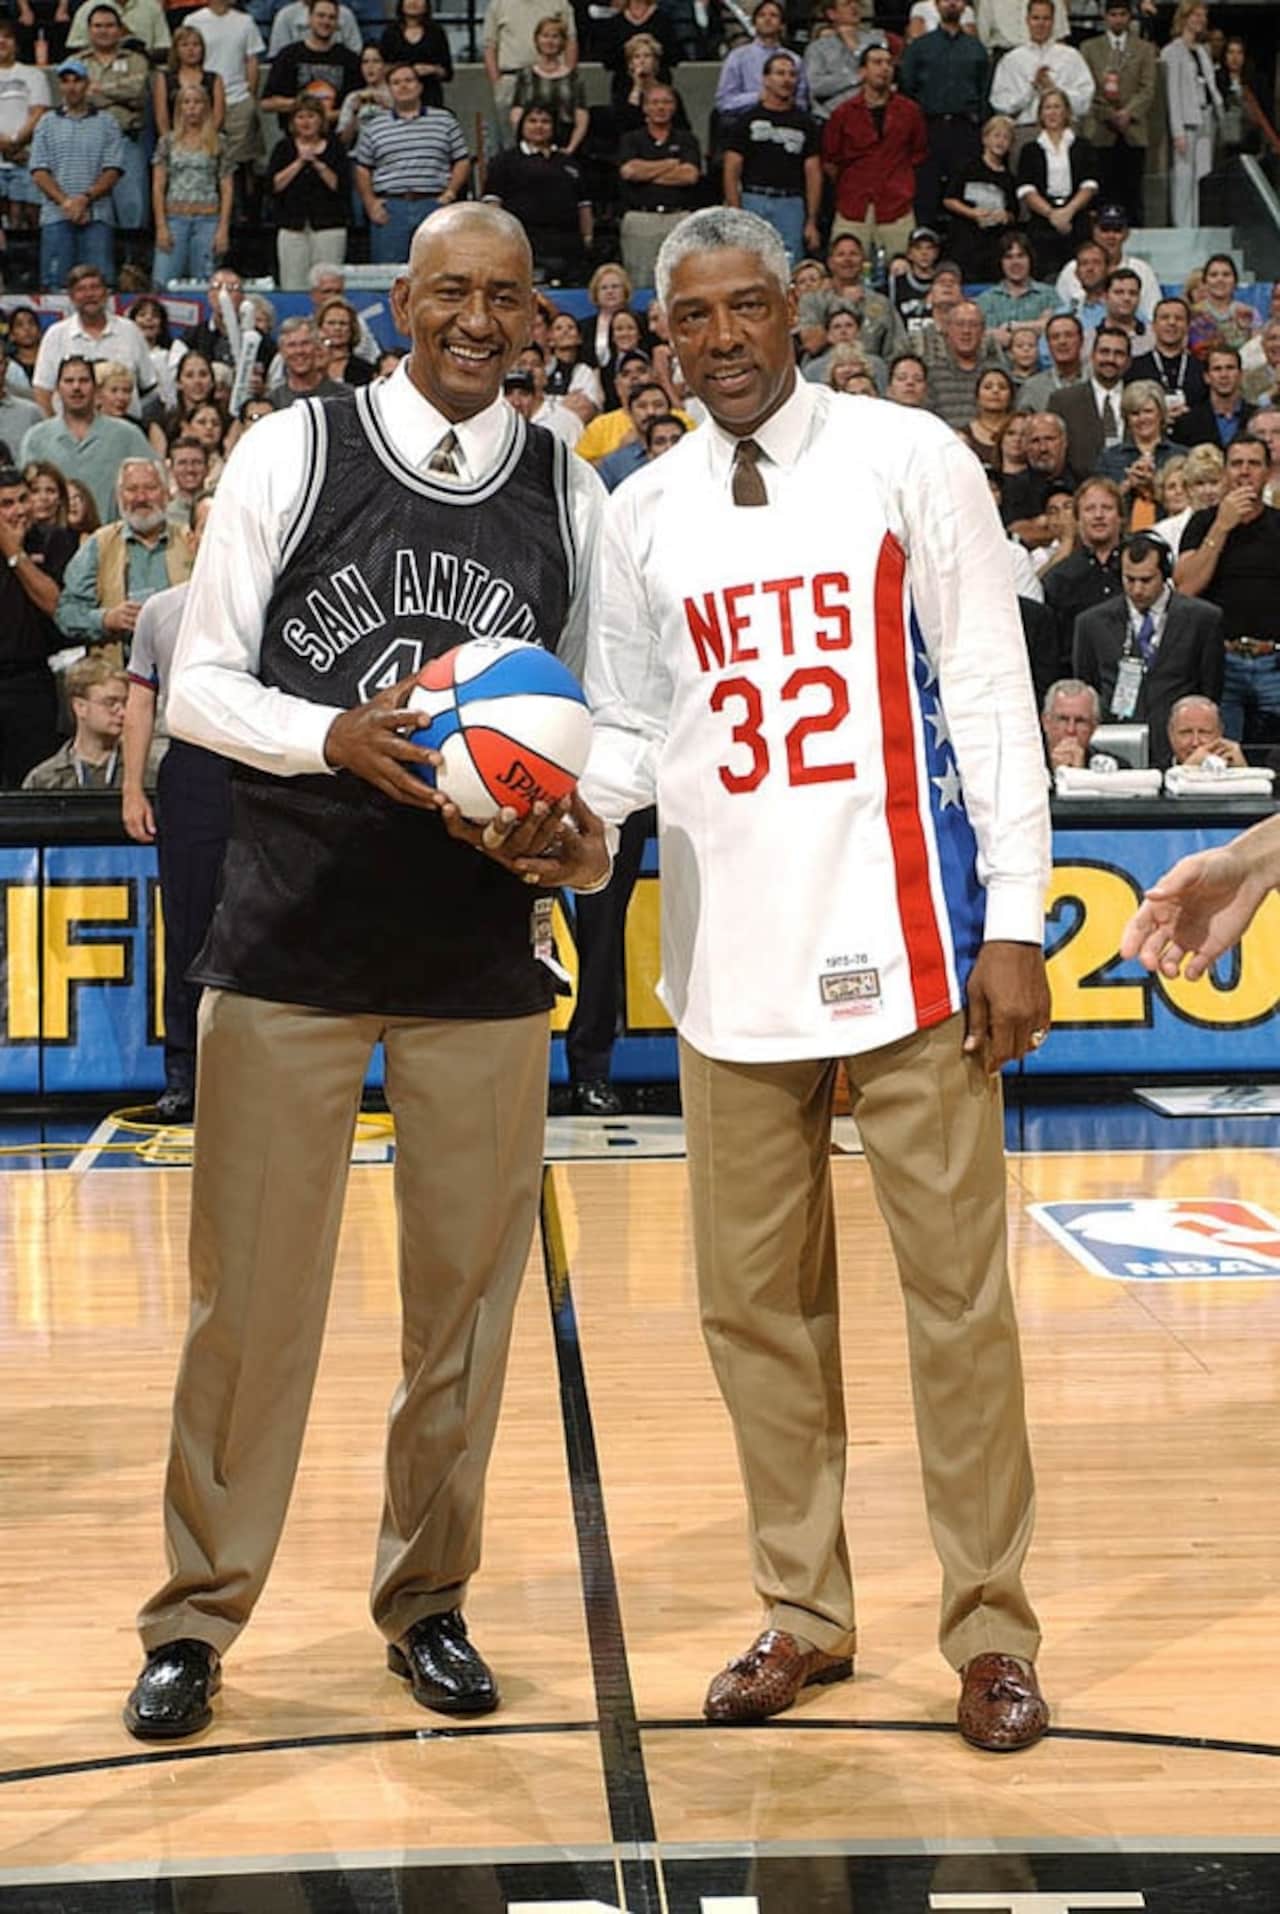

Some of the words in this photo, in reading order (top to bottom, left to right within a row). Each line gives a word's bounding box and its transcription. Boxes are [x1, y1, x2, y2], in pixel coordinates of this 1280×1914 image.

[282, 564, 386, 672] SAN
[395, 549, 544, 643] ANTON
[683, 571, 852, 672] NETS
[709, 666, 856, 794] 32
[1122, 1259, 1267, 1276] NBA
